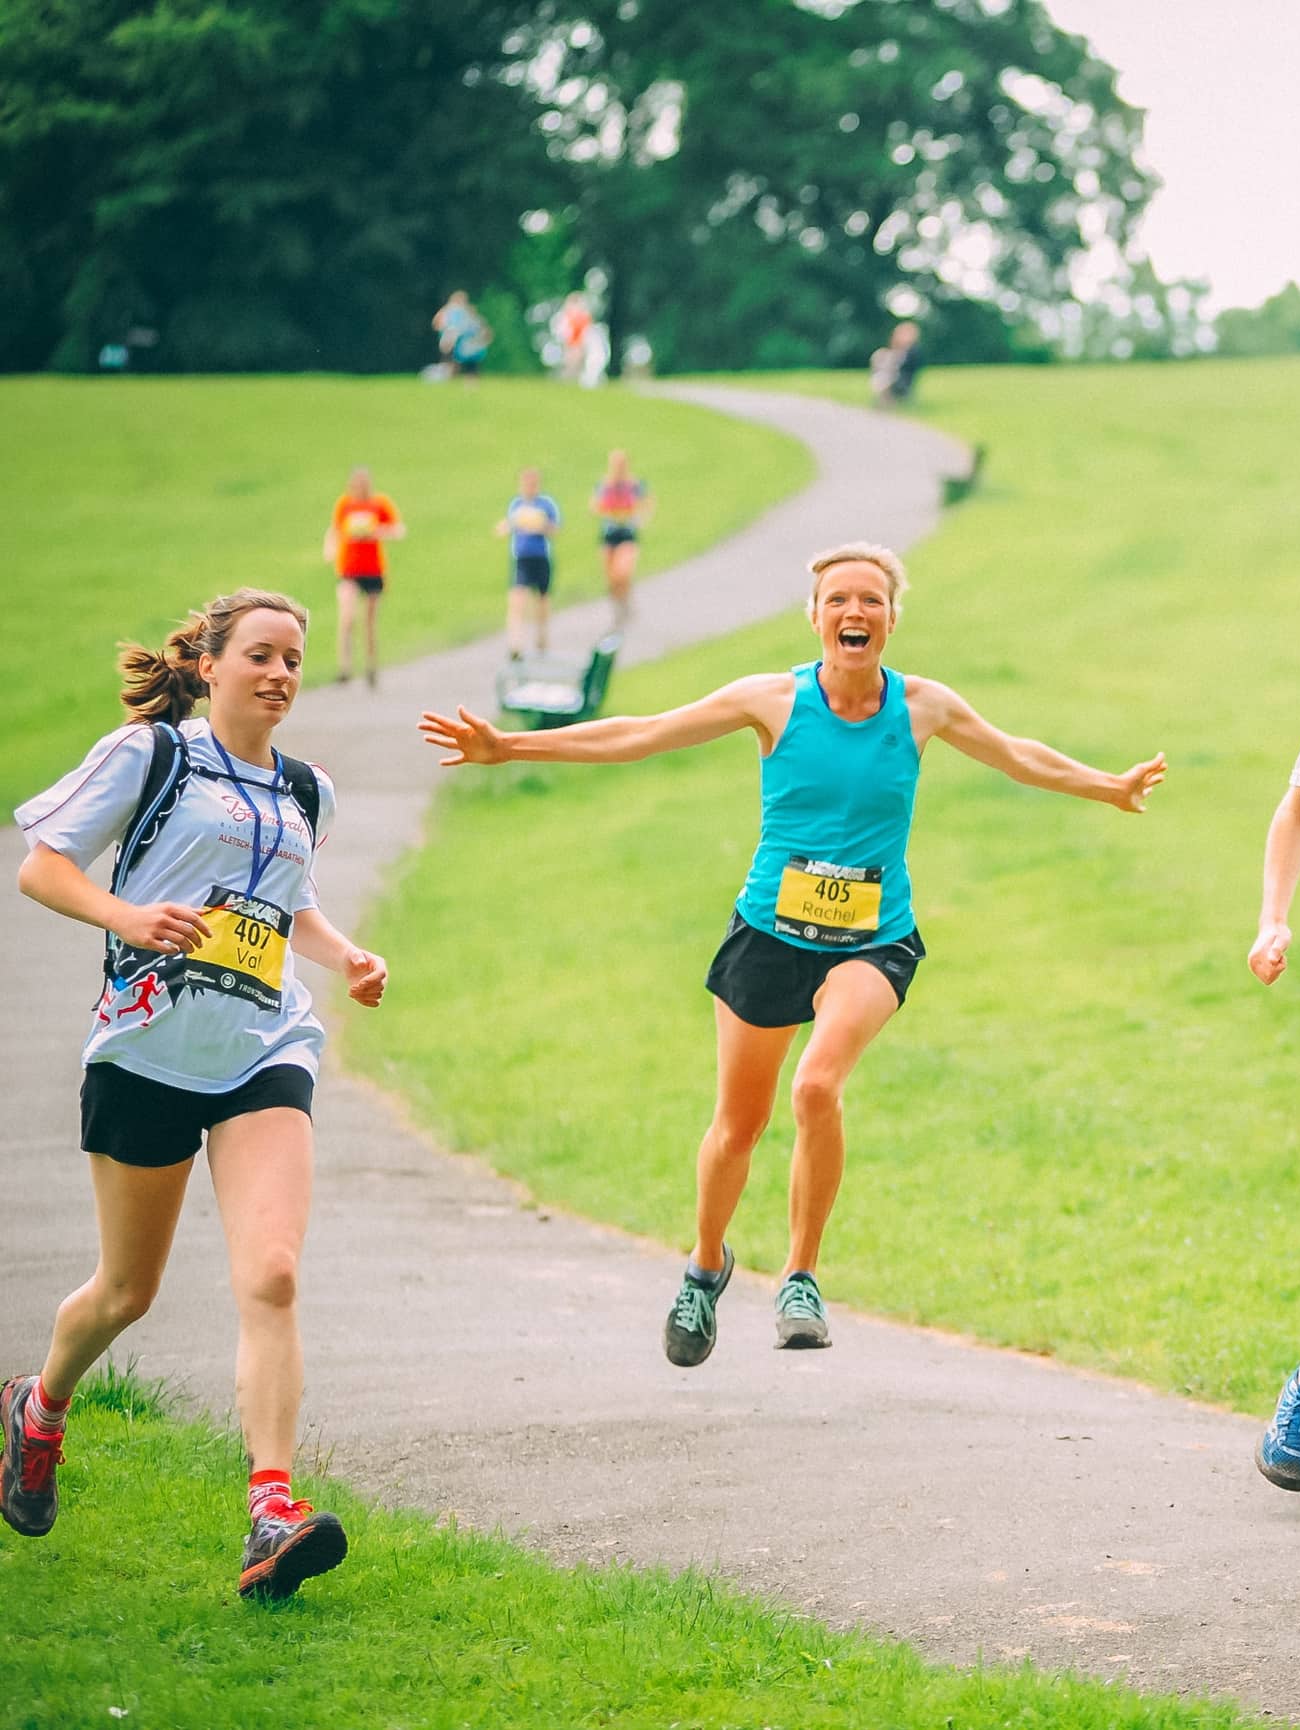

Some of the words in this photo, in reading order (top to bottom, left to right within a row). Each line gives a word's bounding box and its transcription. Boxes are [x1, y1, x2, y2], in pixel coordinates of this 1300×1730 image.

[815, 879, 850, 904] 405
[802, 901, 856, 923] Rachel
[234, 918, 272, 950] 407
[237, 947, 262, 971] Val
